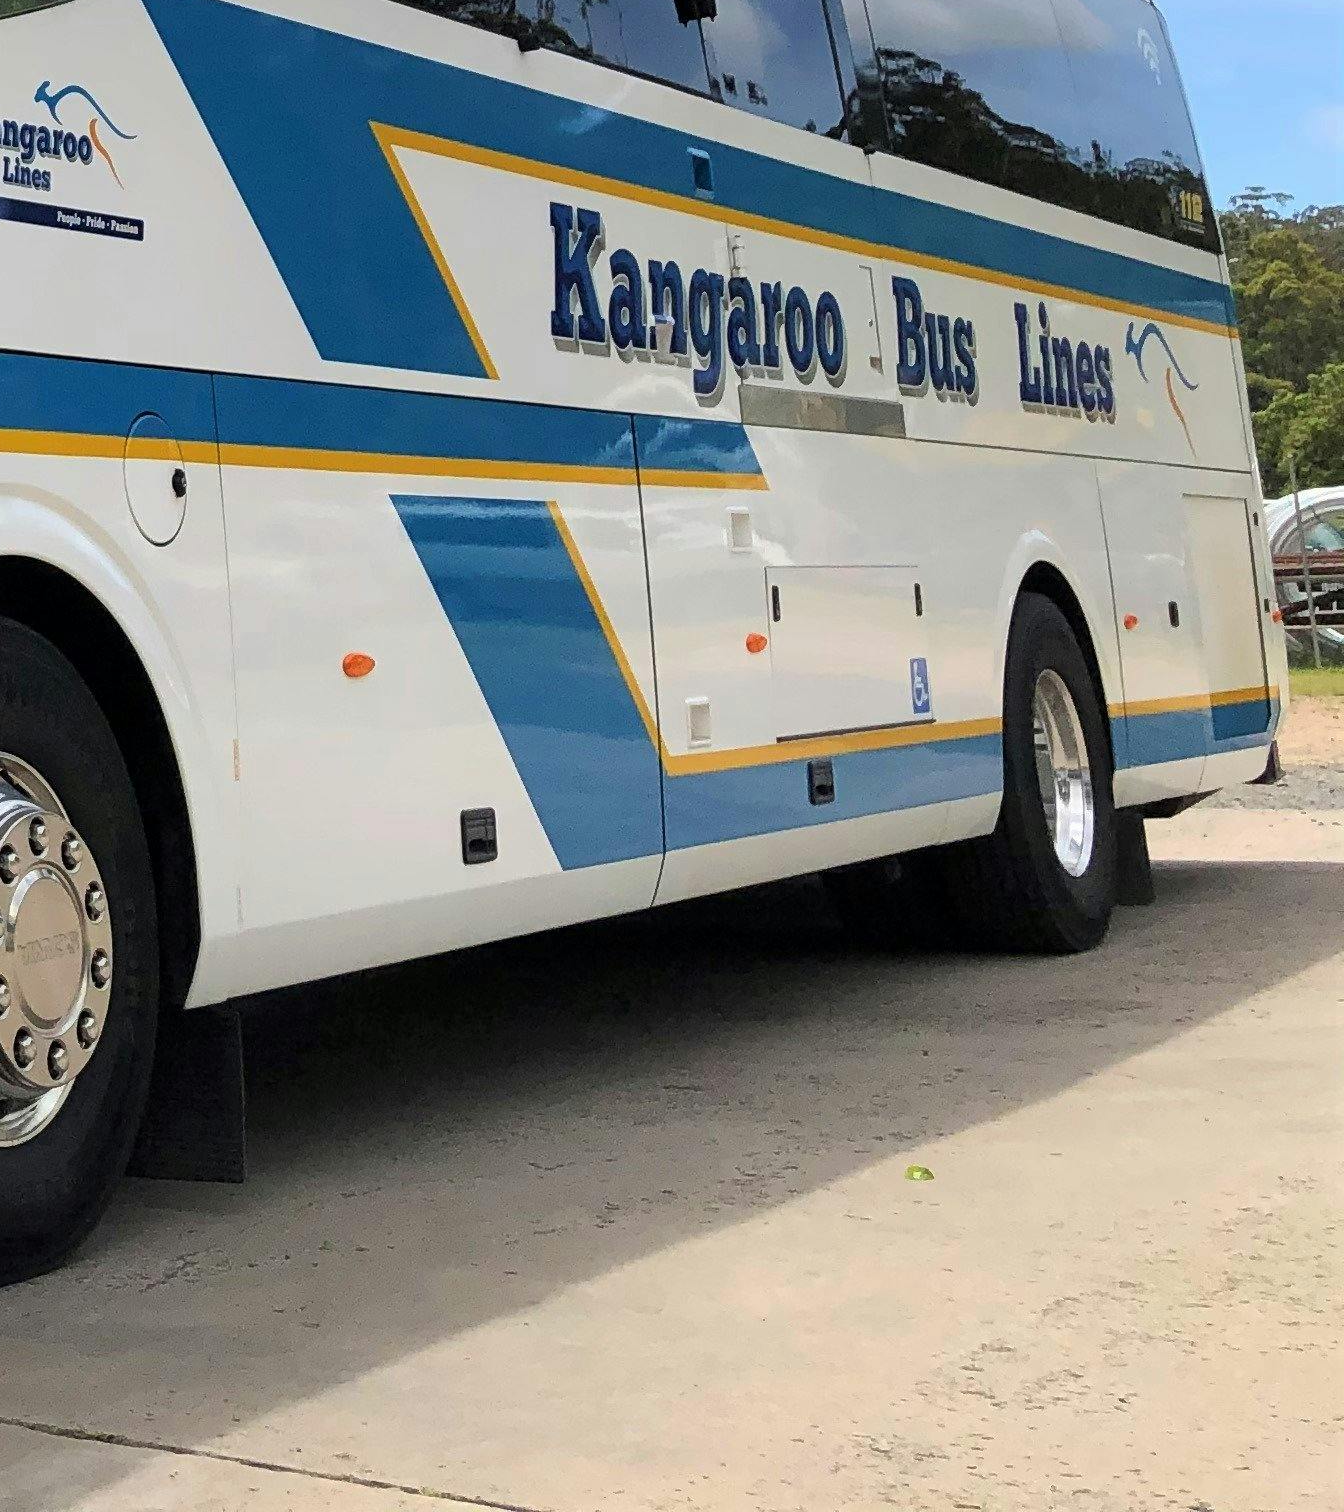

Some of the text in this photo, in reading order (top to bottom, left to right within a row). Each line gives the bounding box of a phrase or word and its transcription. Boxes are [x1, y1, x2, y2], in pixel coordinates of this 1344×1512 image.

[2, 156, 51, 192] Lines
[56, 211, 139, 235] People Pride Passion
[1179, 190, 1203, 223] 112
[549, 201, 1116, 424] Kangaroo Bus Lines
